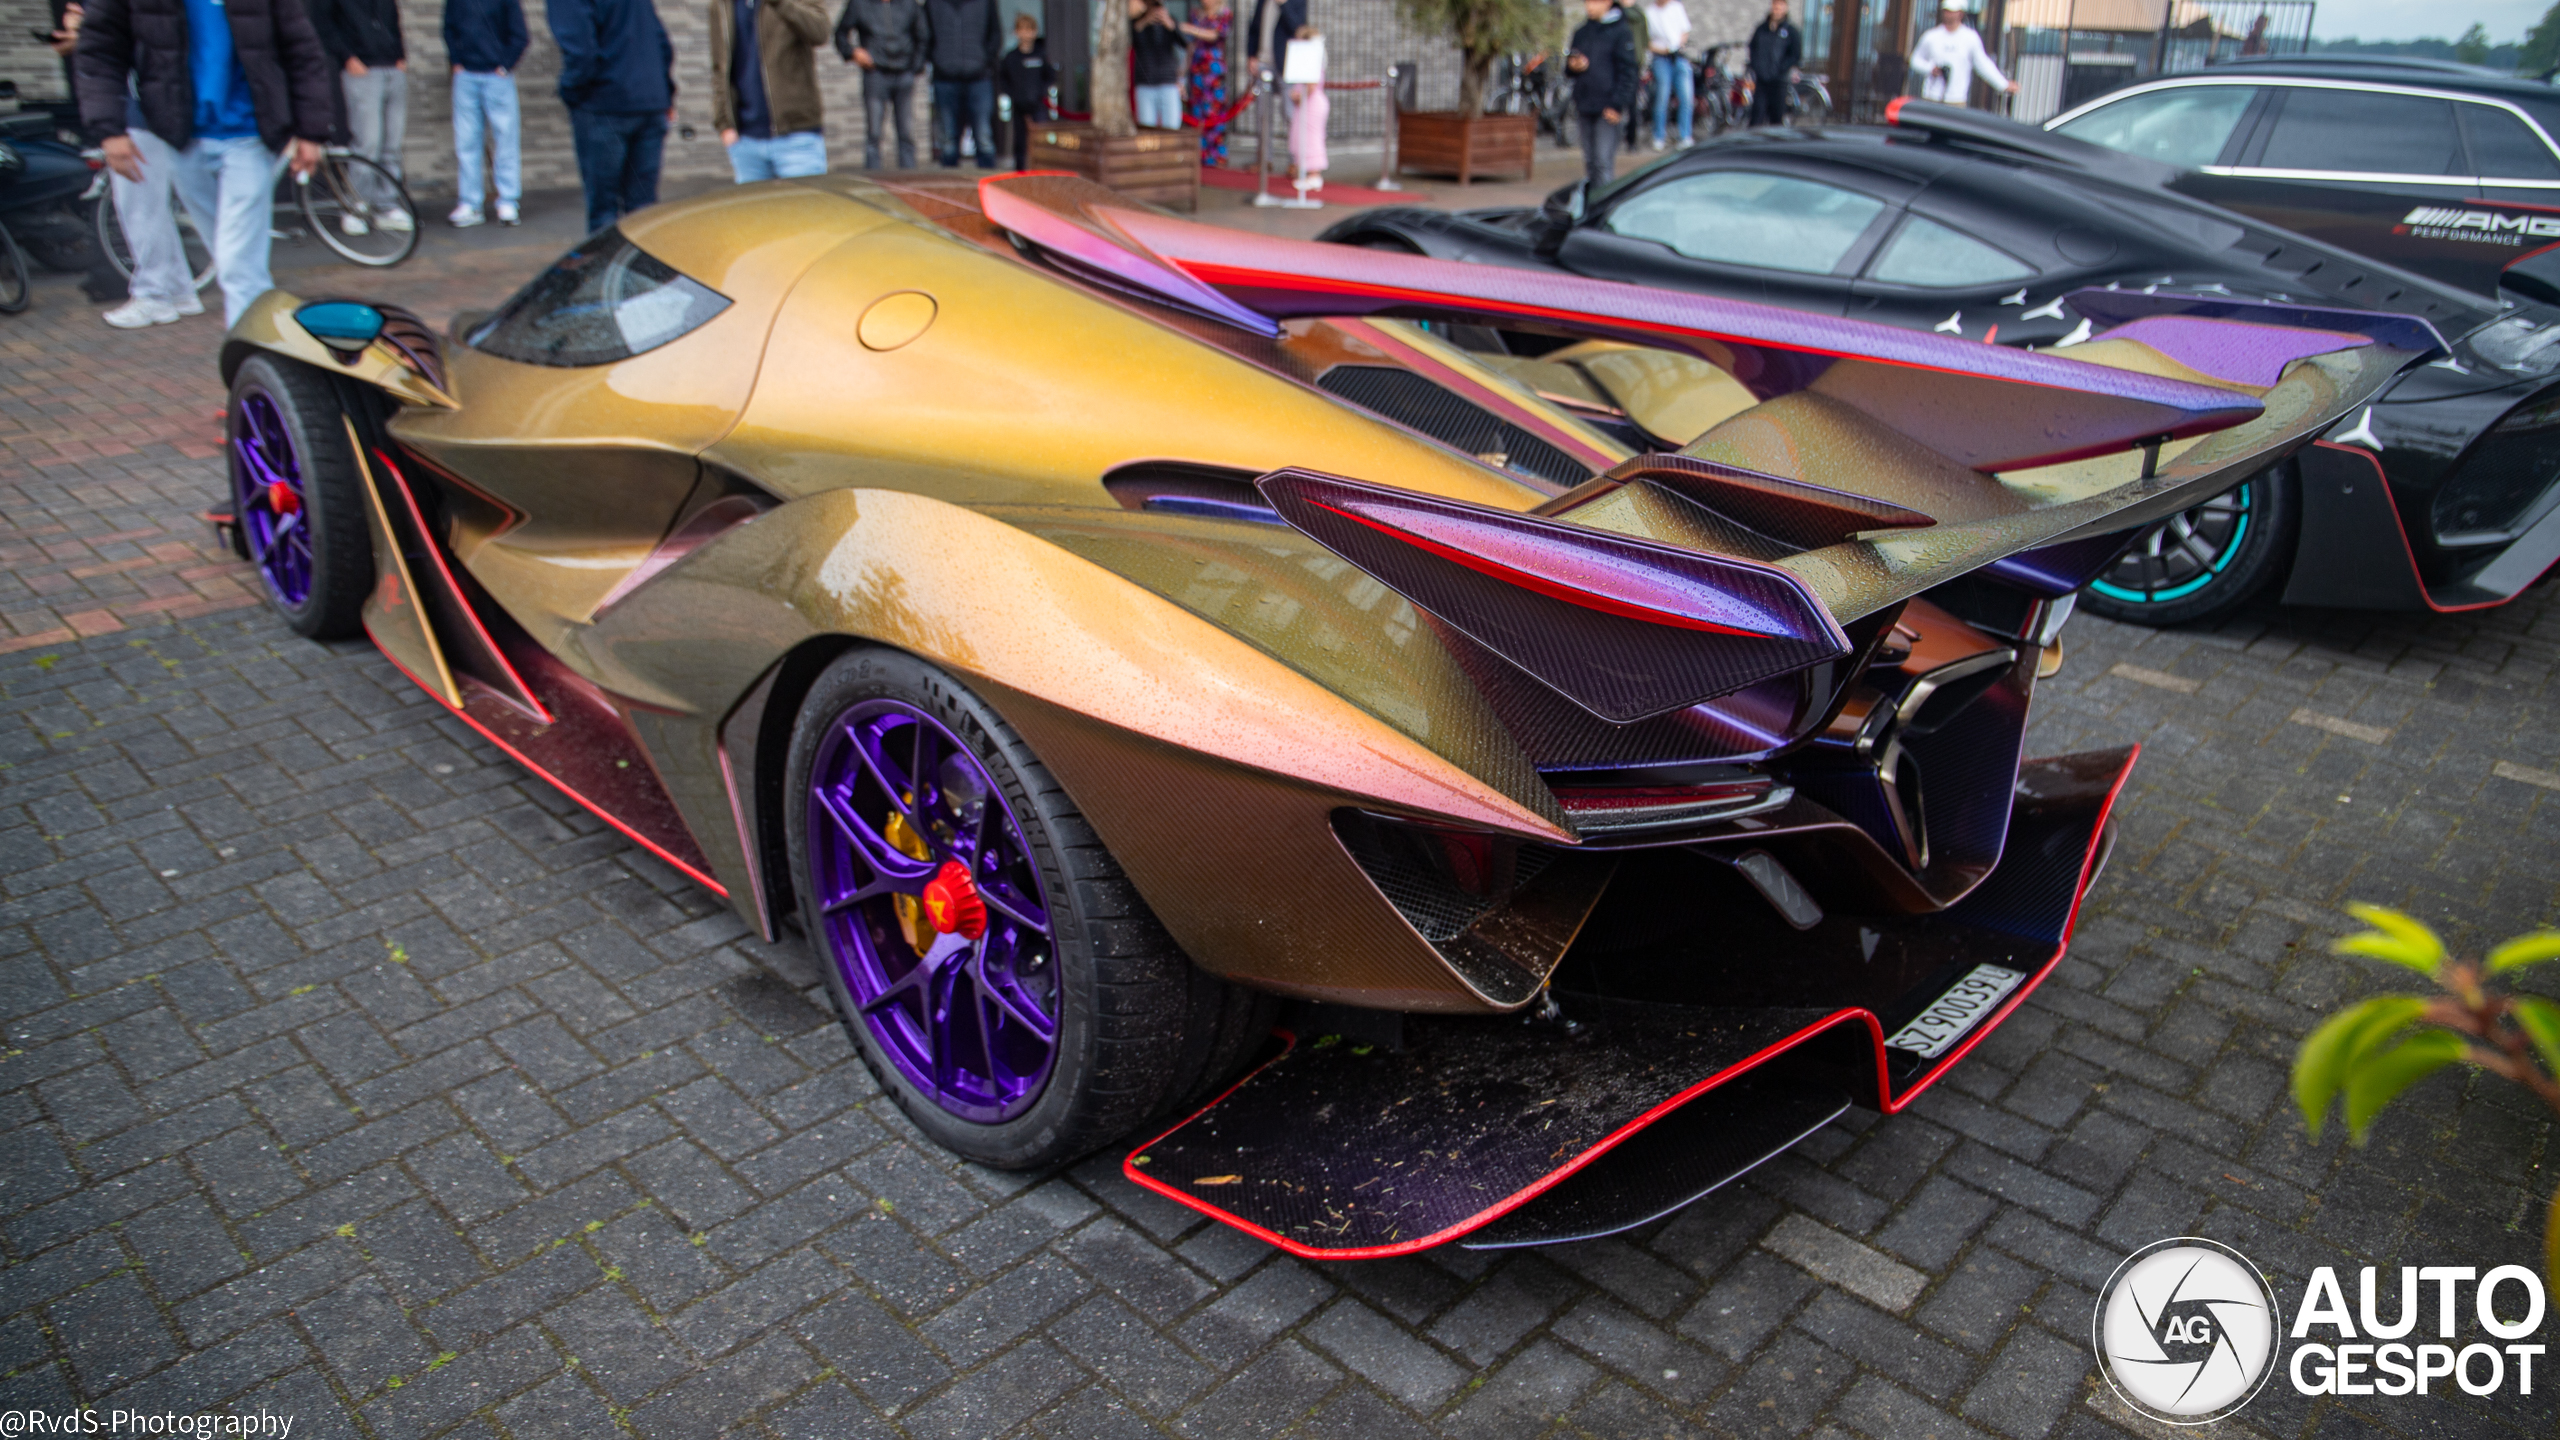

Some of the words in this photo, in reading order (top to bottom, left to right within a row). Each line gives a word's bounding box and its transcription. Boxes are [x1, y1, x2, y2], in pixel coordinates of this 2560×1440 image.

[2411, 225, 2523, 247] PERFORMANCE
[2452, 210, 2560, 237] AMG
[987, 751, 1078, 938] MICHELIN
